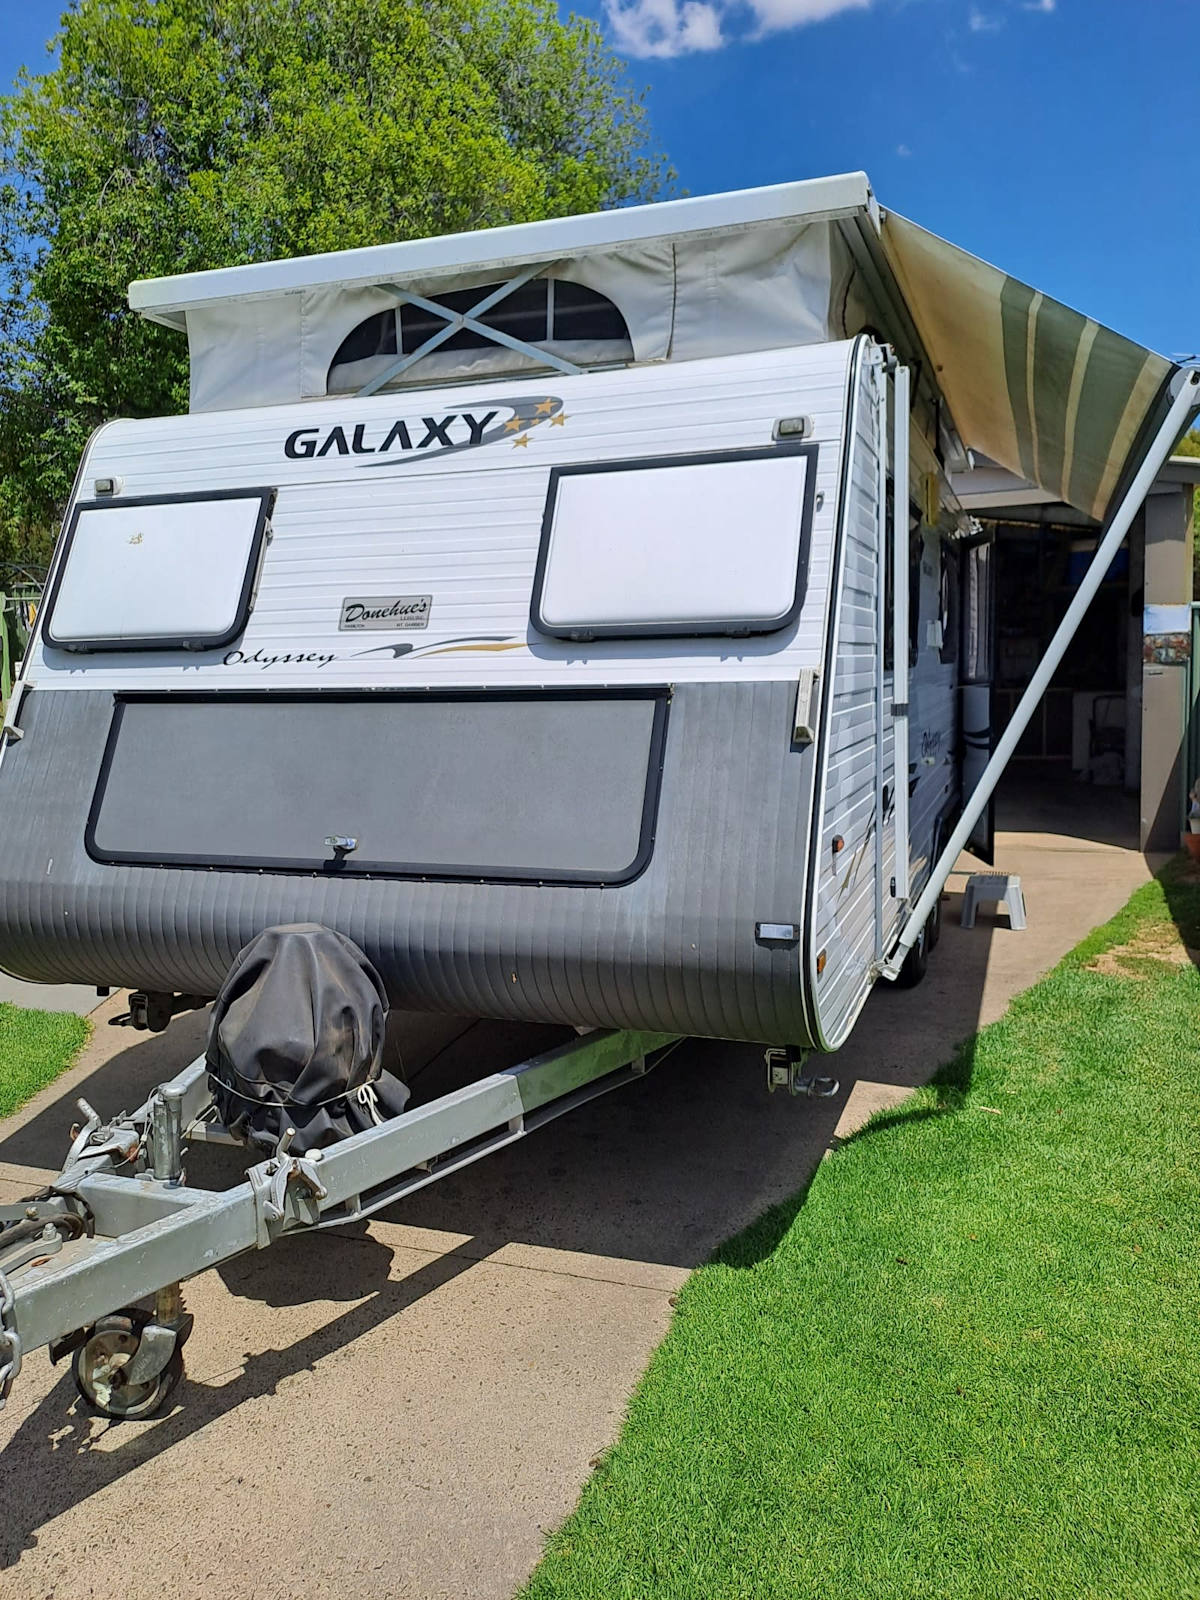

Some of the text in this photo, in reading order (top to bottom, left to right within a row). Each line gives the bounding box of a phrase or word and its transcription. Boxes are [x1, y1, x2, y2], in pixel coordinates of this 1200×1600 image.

[284, 411, 499, 459] GALAXY
[345, 598, 427, 622] Donehue's
[223, 648, 338, 670] Odyssey
